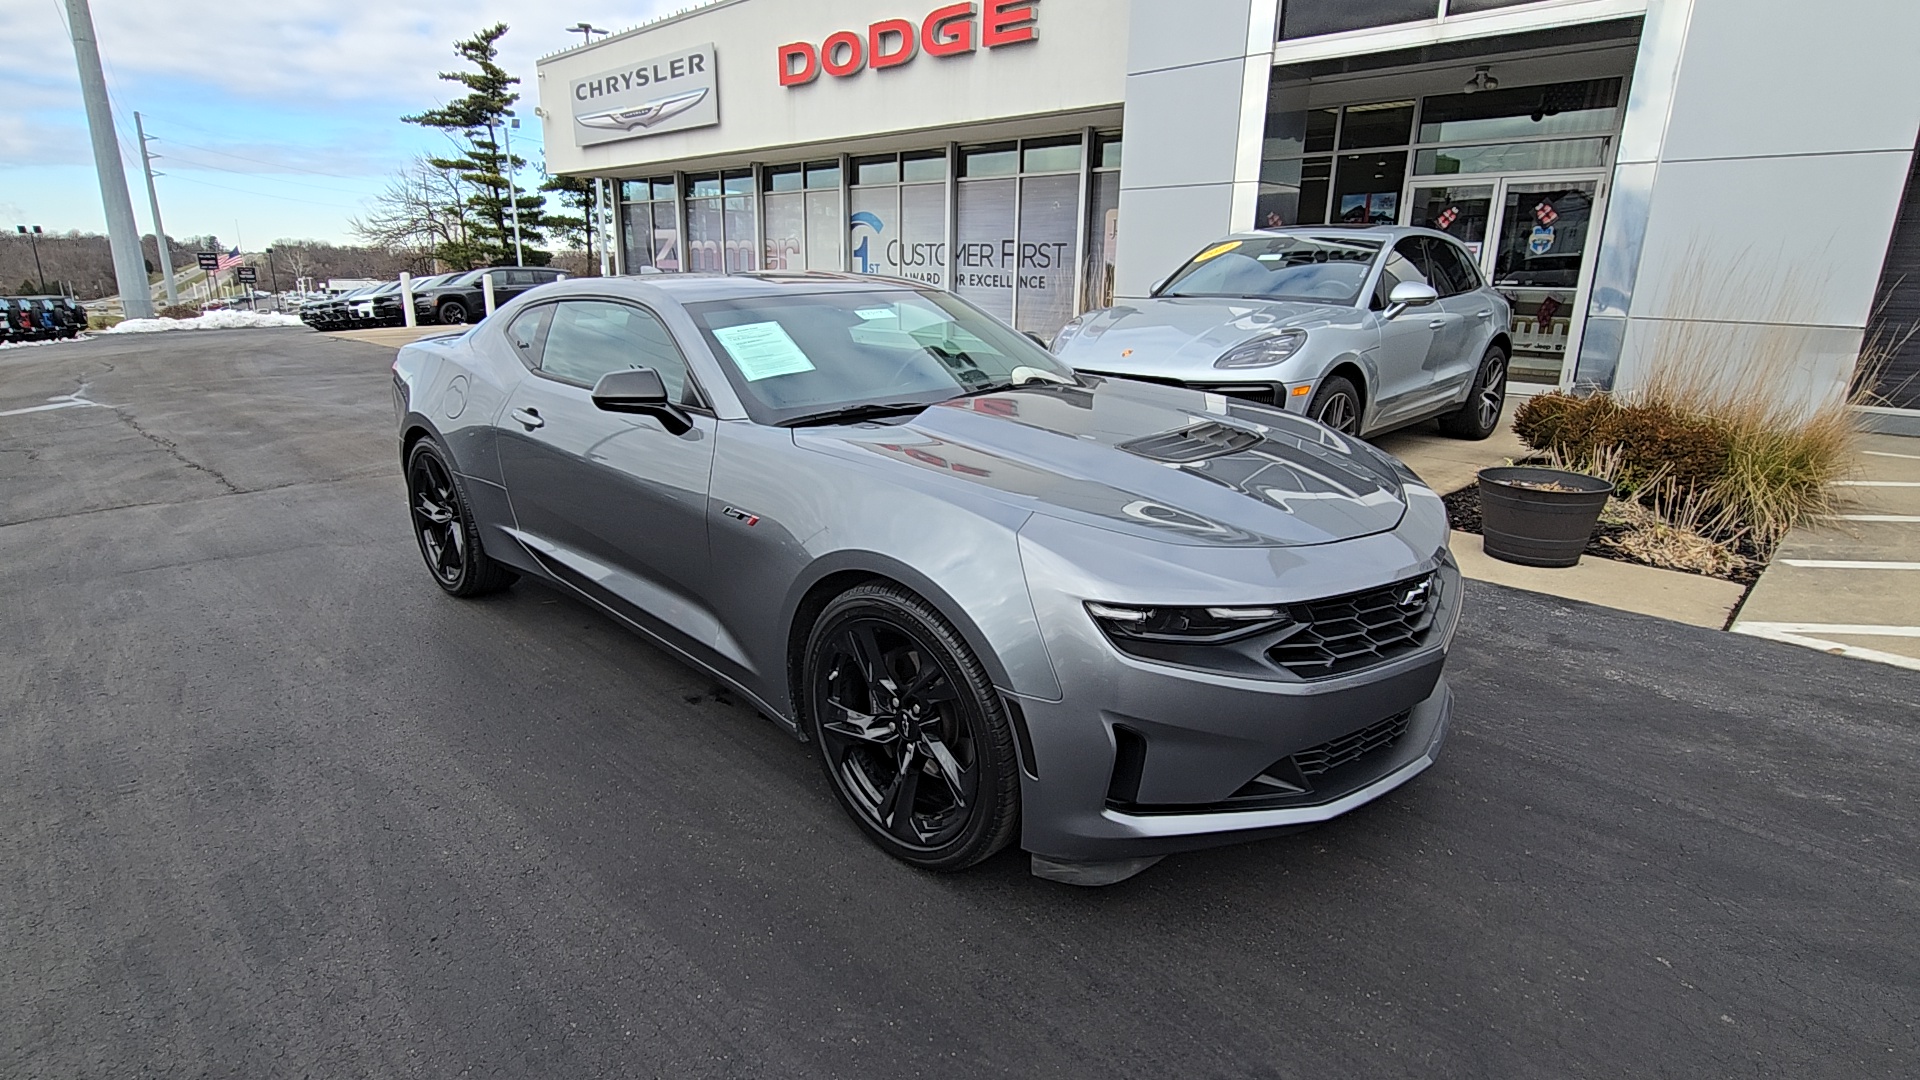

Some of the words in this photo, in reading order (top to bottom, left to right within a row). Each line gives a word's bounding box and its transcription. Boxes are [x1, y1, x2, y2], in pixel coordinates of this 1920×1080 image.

[778, 0, 1038, 86] DODGE
[575, 53, 705, 101] CHRYSLER
[654, 228, 800, 271] Zmmer
[969, 273, 1046, 290] EXCELLNCE
[722, 505, 760, 527] LT1
